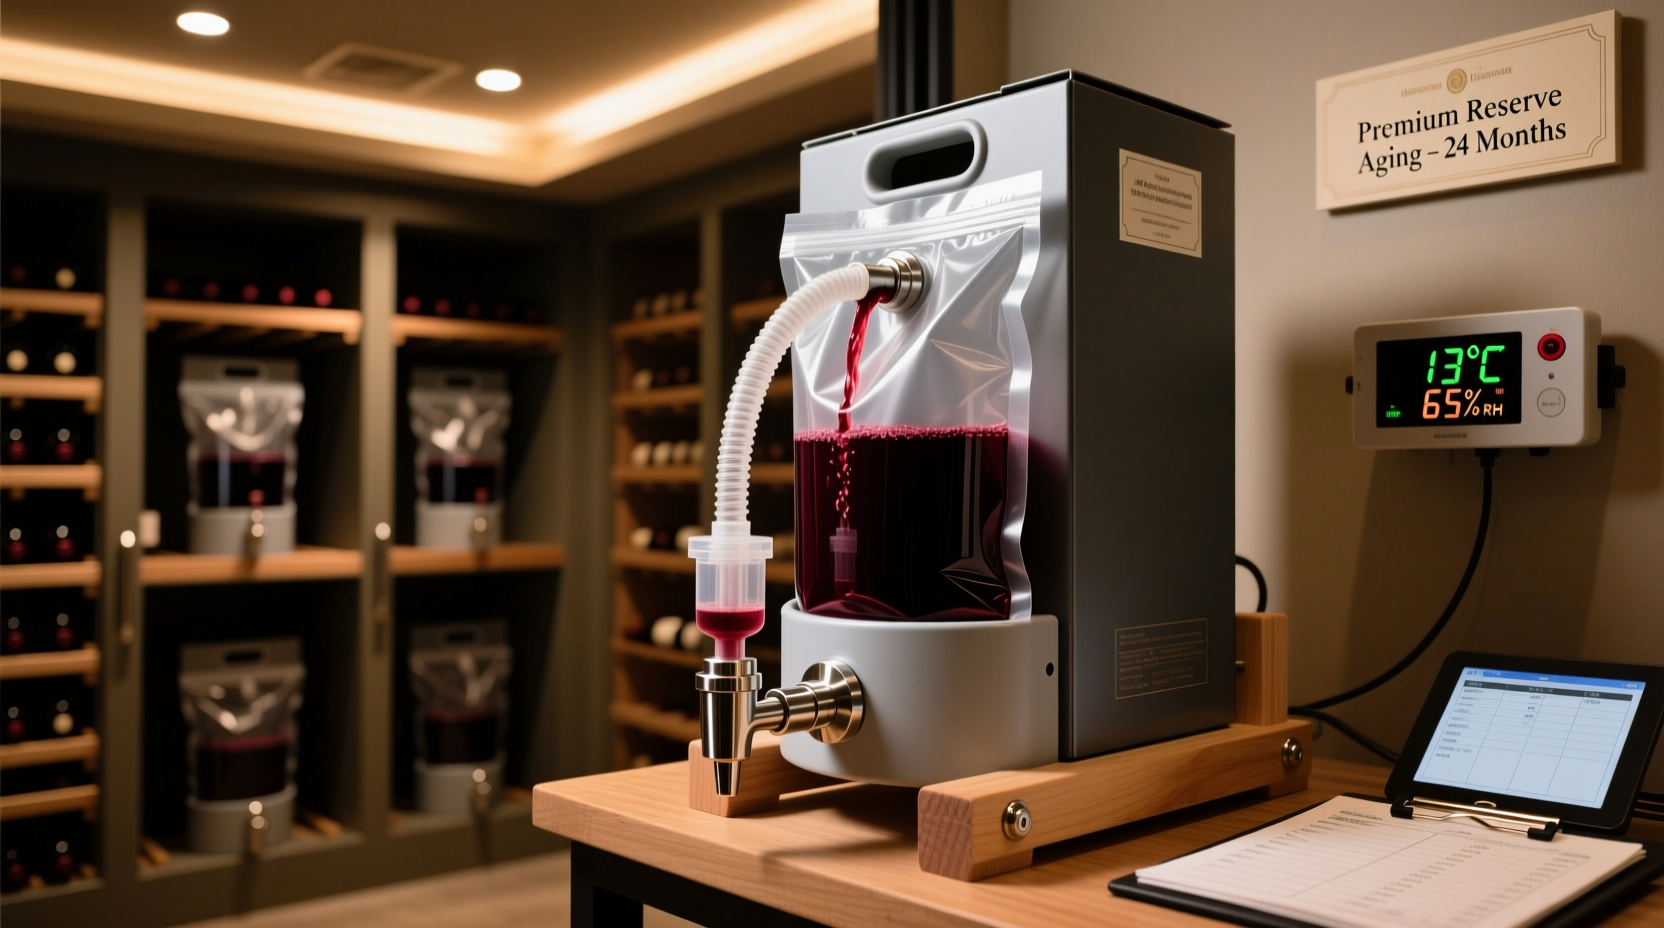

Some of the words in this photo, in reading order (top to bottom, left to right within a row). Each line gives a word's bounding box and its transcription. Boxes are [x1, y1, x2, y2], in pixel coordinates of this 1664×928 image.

[1357, 109, 1459, 144] Premium
[1466, 88, 1562, 123] Reserve
[1357, 146, 1422, 178] Aging
[1444, 133, 1469, 159] 24
[1476, 117, 1567, 154] Months
[1427, 344, 1505, 385] 13°C
[1422, 388, 1482, 420] 65%
[1483, 403, 1503, 417] RH
